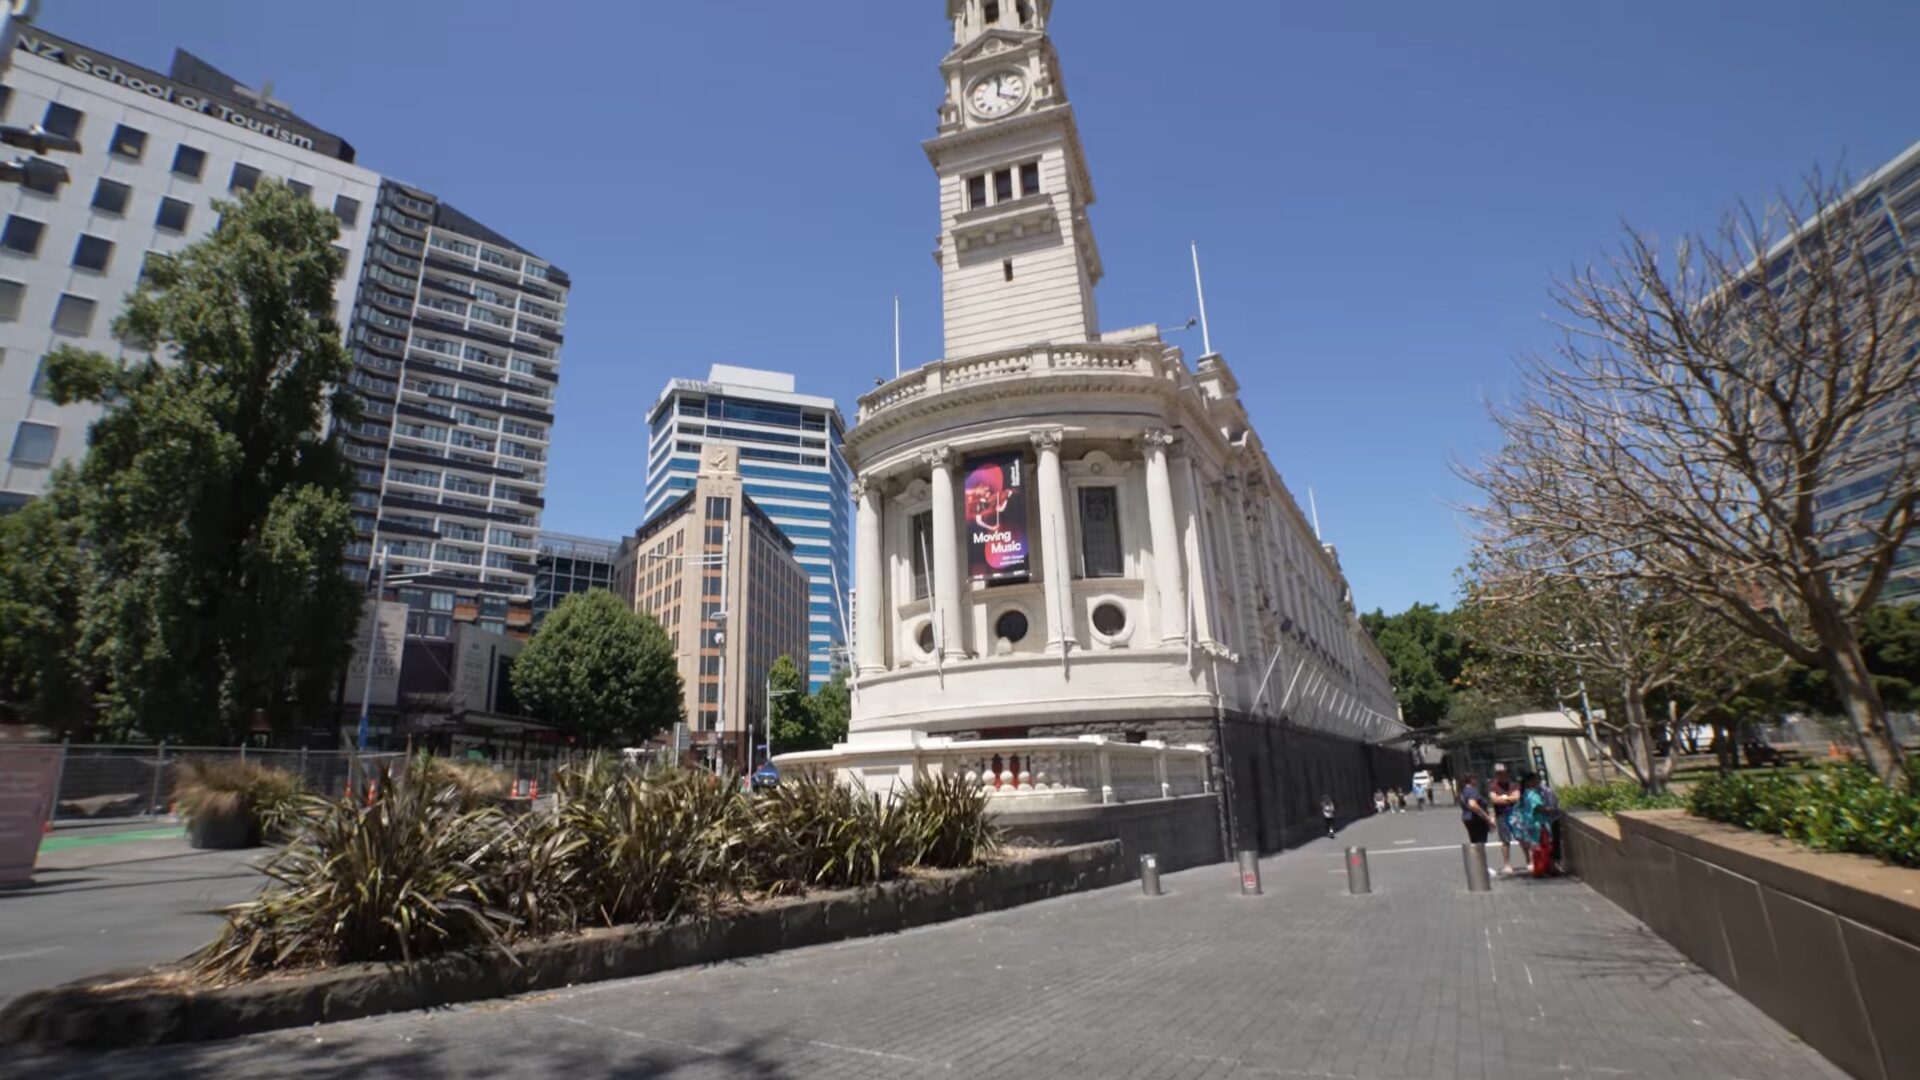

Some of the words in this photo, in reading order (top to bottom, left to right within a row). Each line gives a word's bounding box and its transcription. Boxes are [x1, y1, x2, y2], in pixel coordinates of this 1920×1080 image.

[17, 33, 64, 61] NZ
[69, 54, 175, 101] School
[179, 96, 210, 113] of
[218, 103, 314, 150] Tourism
[973, 531, 1012, 544] Moving
[991, 540, 1022, 554] Music
